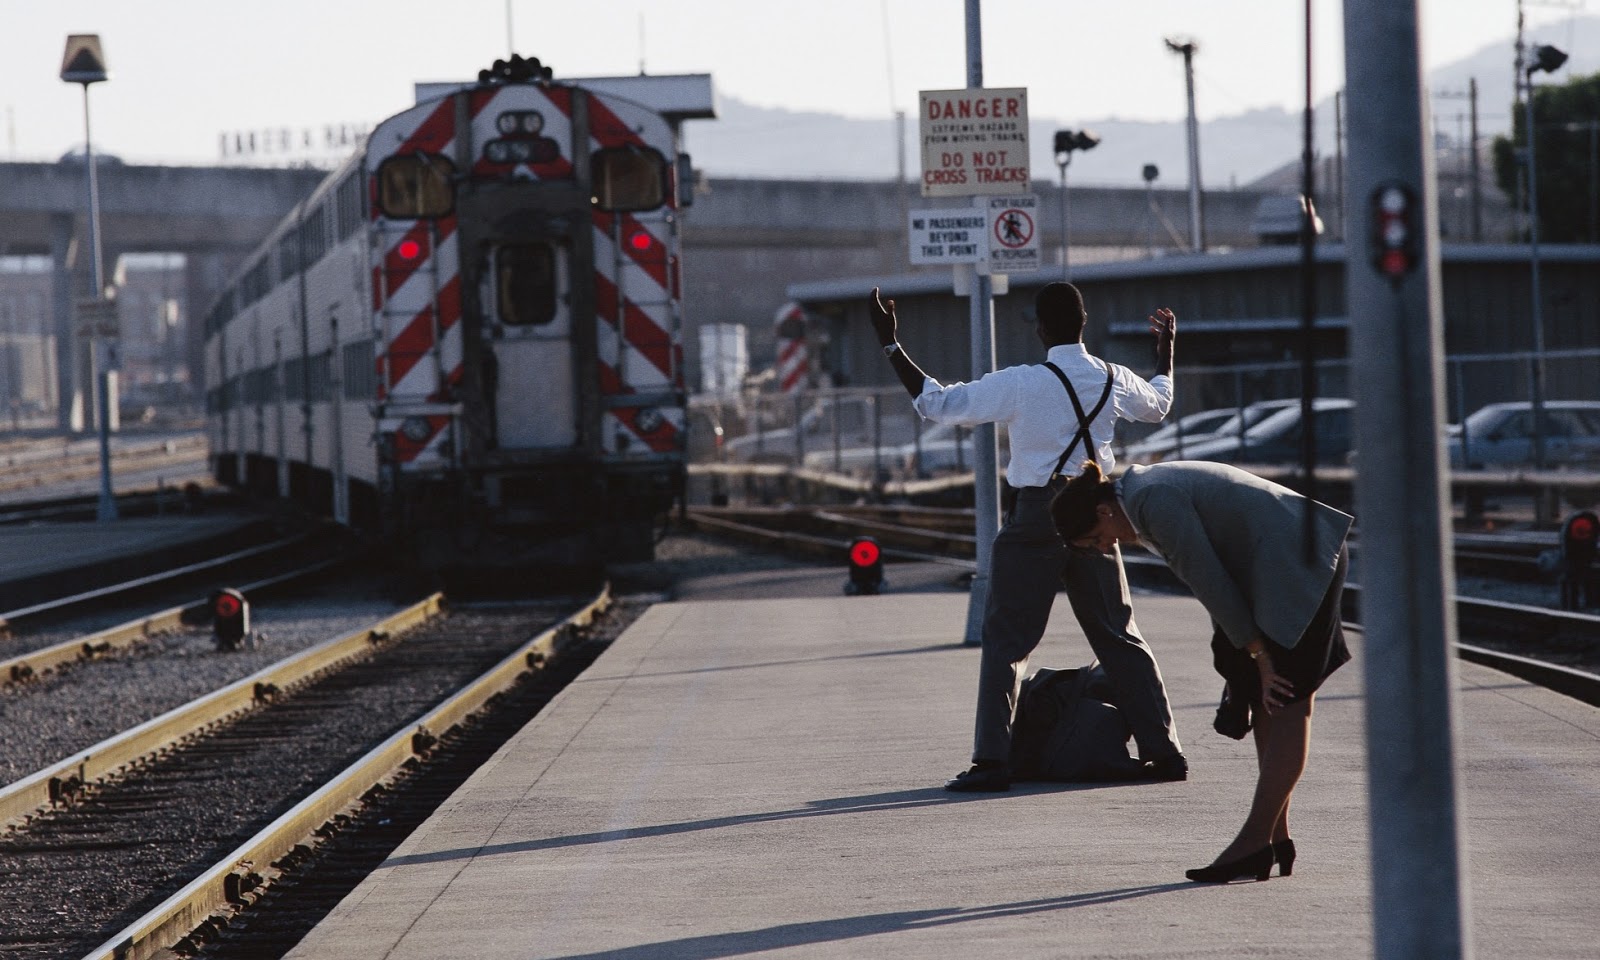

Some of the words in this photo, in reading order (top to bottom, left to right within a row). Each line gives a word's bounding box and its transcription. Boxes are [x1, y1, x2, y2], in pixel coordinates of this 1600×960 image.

[928, 98, 1019, 120] DANGER
[932, 124, 975, 133] EXTREME
[980, 122, 1017, 131] HAZARD
[927, 135, 948, 143] FROM
[952, 134, 987, 143] MOVING
[942, 152, 964, 168] DO
[973, 150, 1008, 166] NOT
[924, 169, 968, 185] CROSS
[975, 167, 1027, 183] TRACKS
[912, 218, 926, 231] NO
[929, 217, 985, 230] PASSENGERS
[929, 231, 969, 244] BEYOND
[921, 245, 944, 257] THIS
[948, 243, 978, 256] POINT
